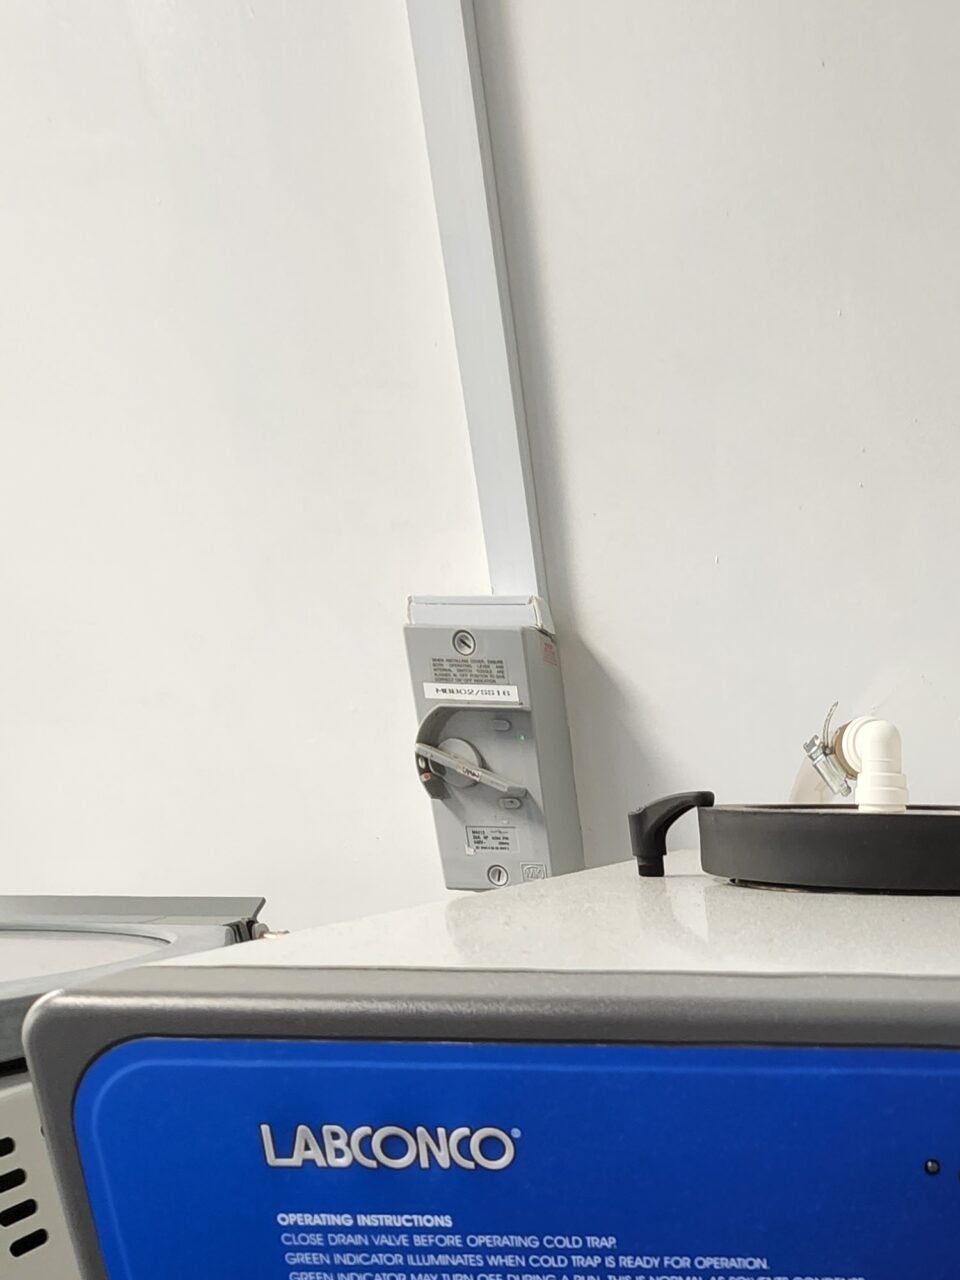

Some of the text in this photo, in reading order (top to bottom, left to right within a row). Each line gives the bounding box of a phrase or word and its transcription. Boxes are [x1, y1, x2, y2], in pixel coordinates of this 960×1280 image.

[276, 1213, 454, 1227] OPERATING INSTRUCTIONS
[280, 1233, 325, 1245] CLOSE
[327, 1234, 370, 1245] DRAIN
[370, 1235, 410, 1246] VALVE
[412, 1235, 464, 1247] BEFORE
[465, 1235, 540, 1248] OPERATING
[542, 1236, 583, 1248] COLD
[284, 1253, 331, 1264] GREEN
[333, 1253, 405, 1265] INDICATOR
[406, 1254, 485, 1266] ILLUMINATES
[485, 1255, 527, 1266] WHEN
[528, 1255, 569, 1267] COLD
[570, 1256, 602, 1267] TRAP
[604, 1256, 617, 1268] IS
[618, 1256, 661, 1268] READY
[663, 1257, 692, 1269] FOR
